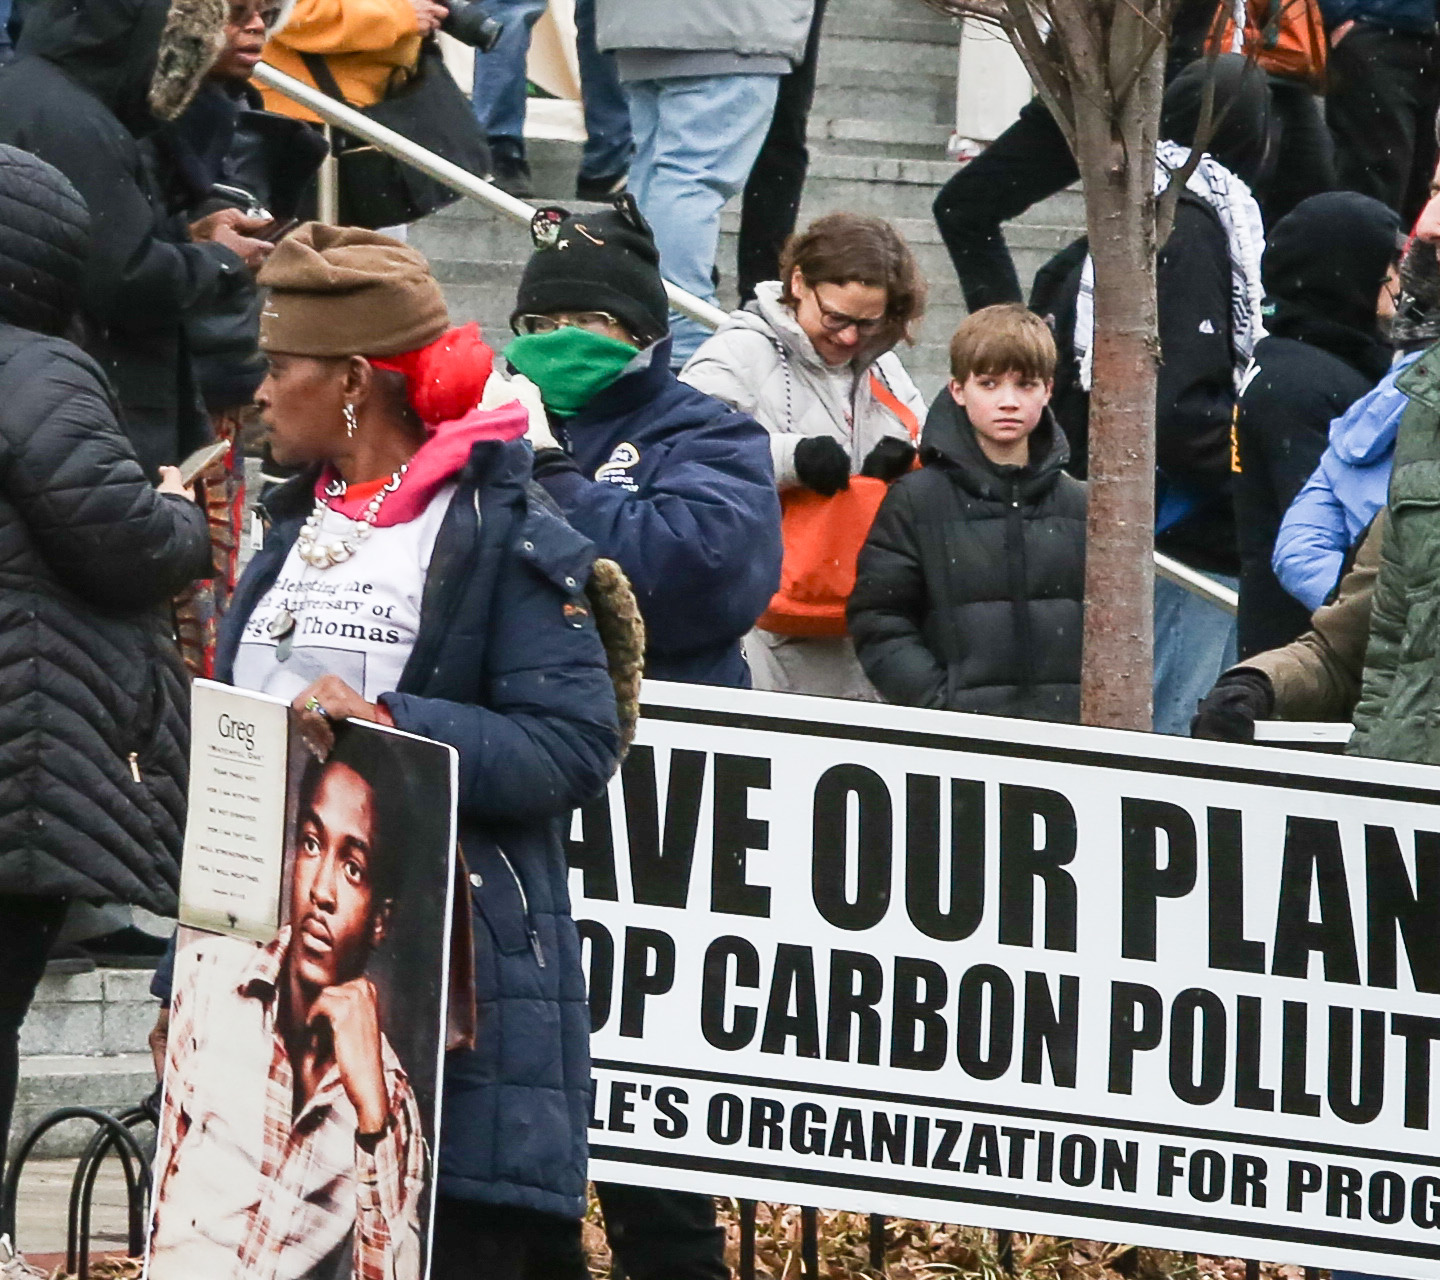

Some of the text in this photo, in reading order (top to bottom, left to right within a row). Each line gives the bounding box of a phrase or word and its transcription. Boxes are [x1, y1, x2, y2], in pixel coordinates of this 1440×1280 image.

[302, 616, 400, 644] Thomas
[373, 605, 397, 619] of
[218, 713, 255, 751] Greg
[811, 762, 1078, 953] OUR
[701, 934, 1080, 1089] CARBON
[707, 1093, 1139, 1192] ORGANIZATION
[1157, 1144, 1268, 1209] FOR
